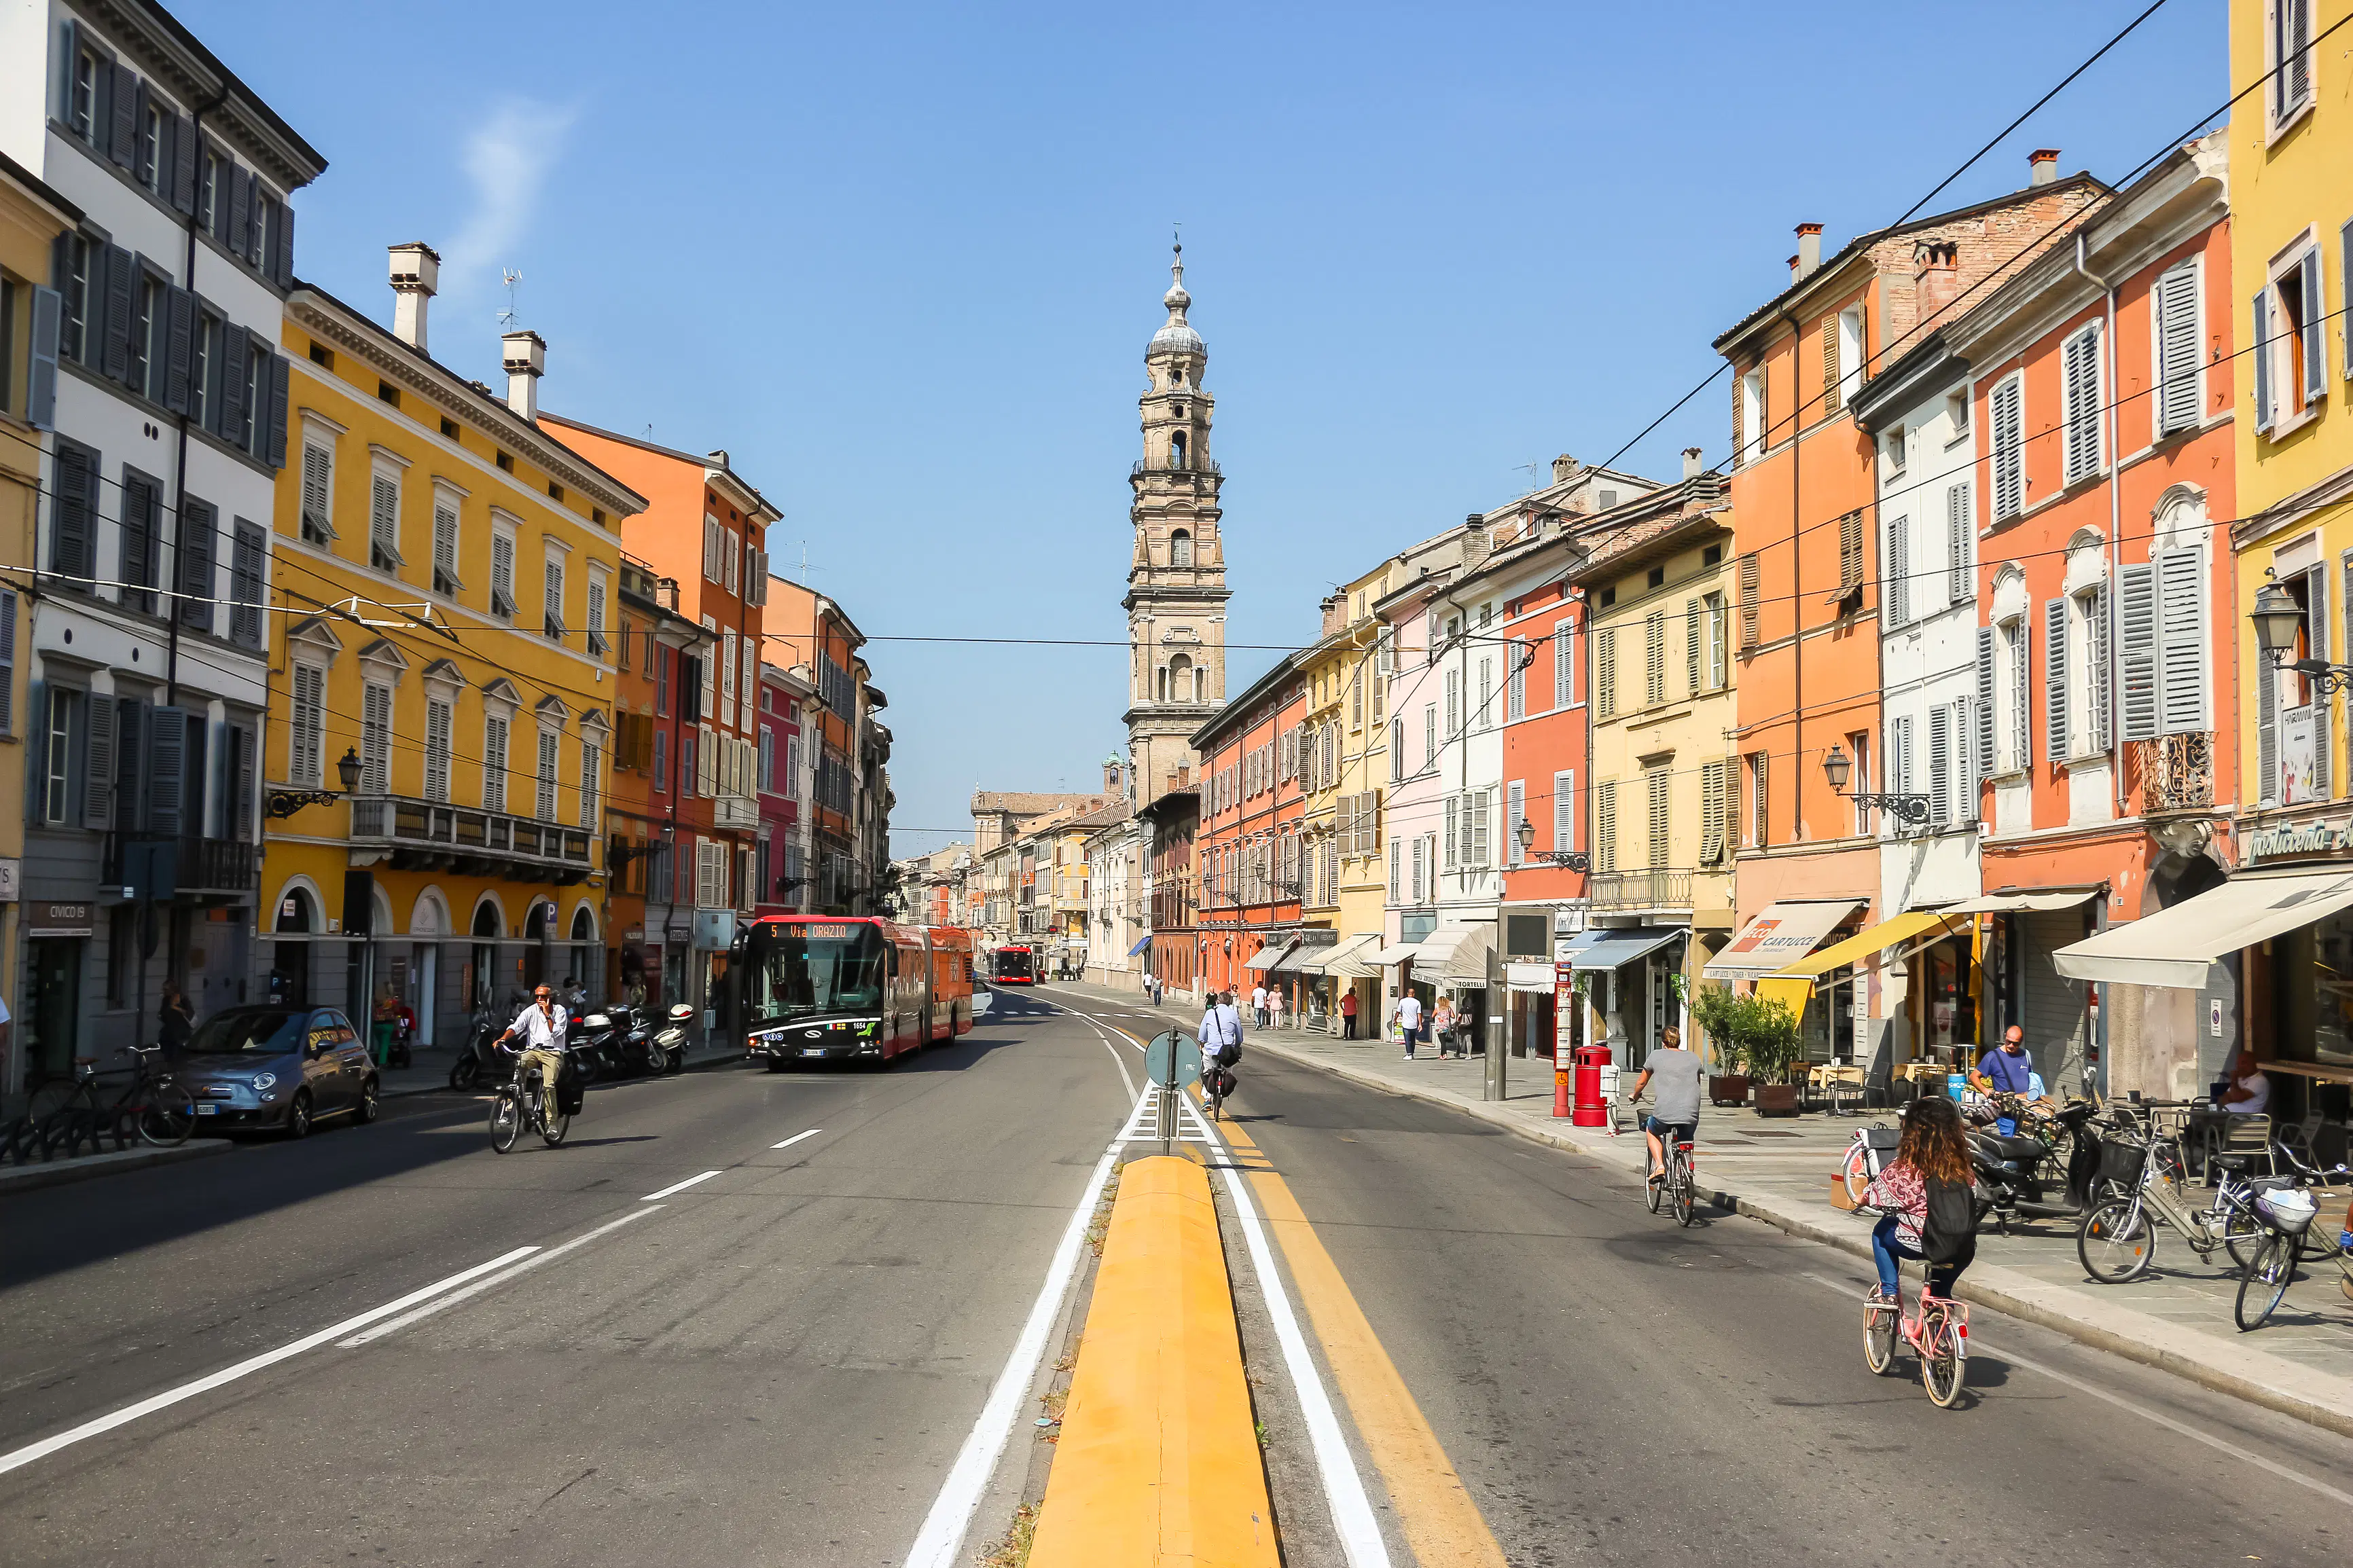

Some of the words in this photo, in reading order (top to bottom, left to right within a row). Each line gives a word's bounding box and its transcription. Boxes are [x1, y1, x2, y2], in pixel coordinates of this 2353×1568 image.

[50, 906, 76, 917] CIVICO
[77, 907, 85, 918] 19
[547, 904, 556, 920] P
[771, 925, 778, 938] 5
[791, 925, 808, 938] Via
[812, 925, 846, 938] ORAZIO
[1745, 928, 1772, 938] ECO
[1762, 936, 1818, 946] CARTUCCE
